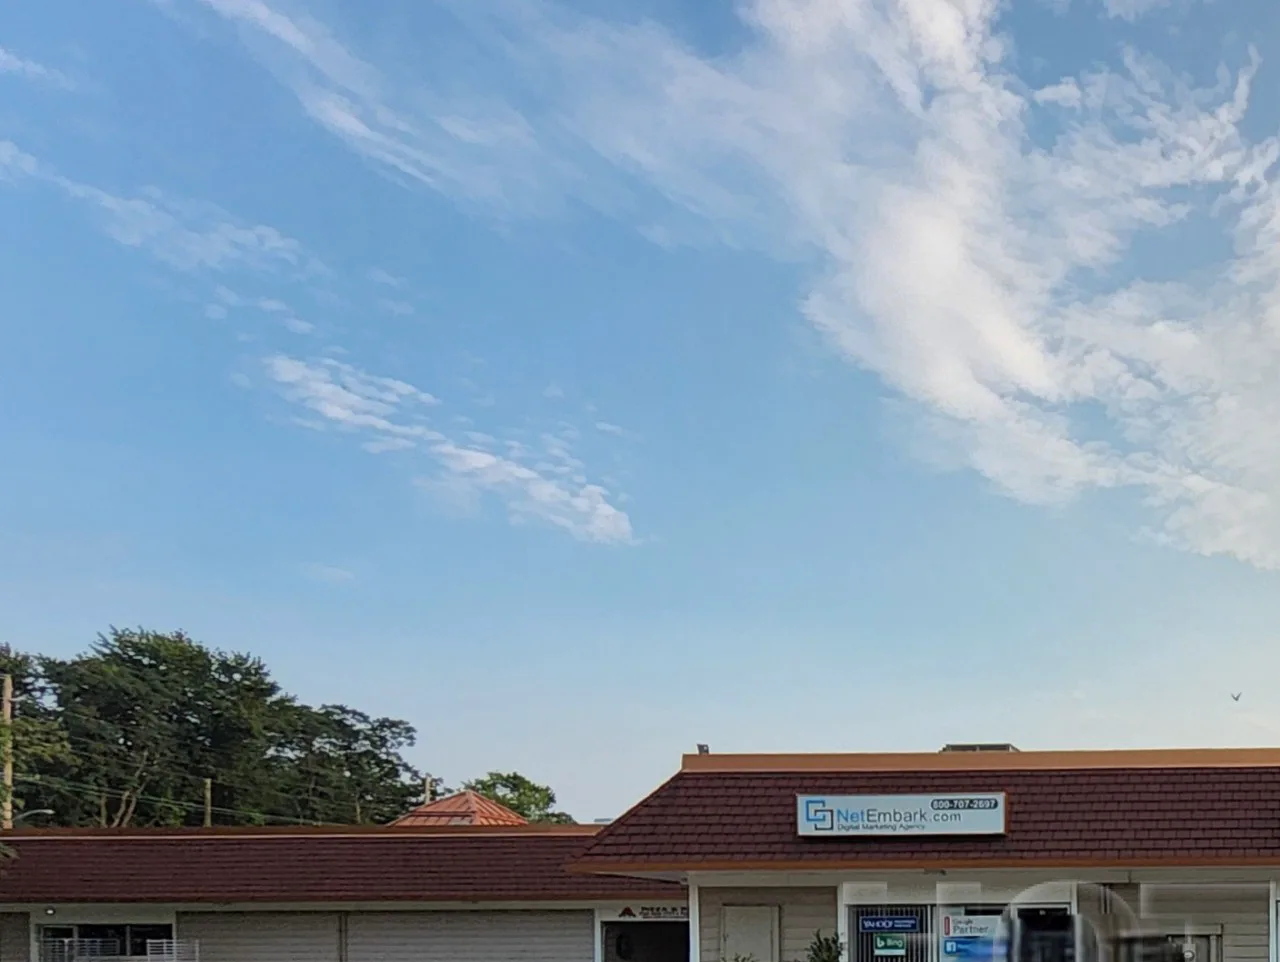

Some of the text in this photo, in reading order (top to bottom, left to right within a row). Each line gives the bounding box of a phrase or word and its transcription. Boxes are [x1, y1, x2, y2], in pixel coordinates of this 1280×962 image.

[837, 808, 962, 824] NetEmbark.com
[837, 824, 860, 832] Digital
[862, 824, 897, 832] Marketing
[953, 926, 988, 935] Partner
